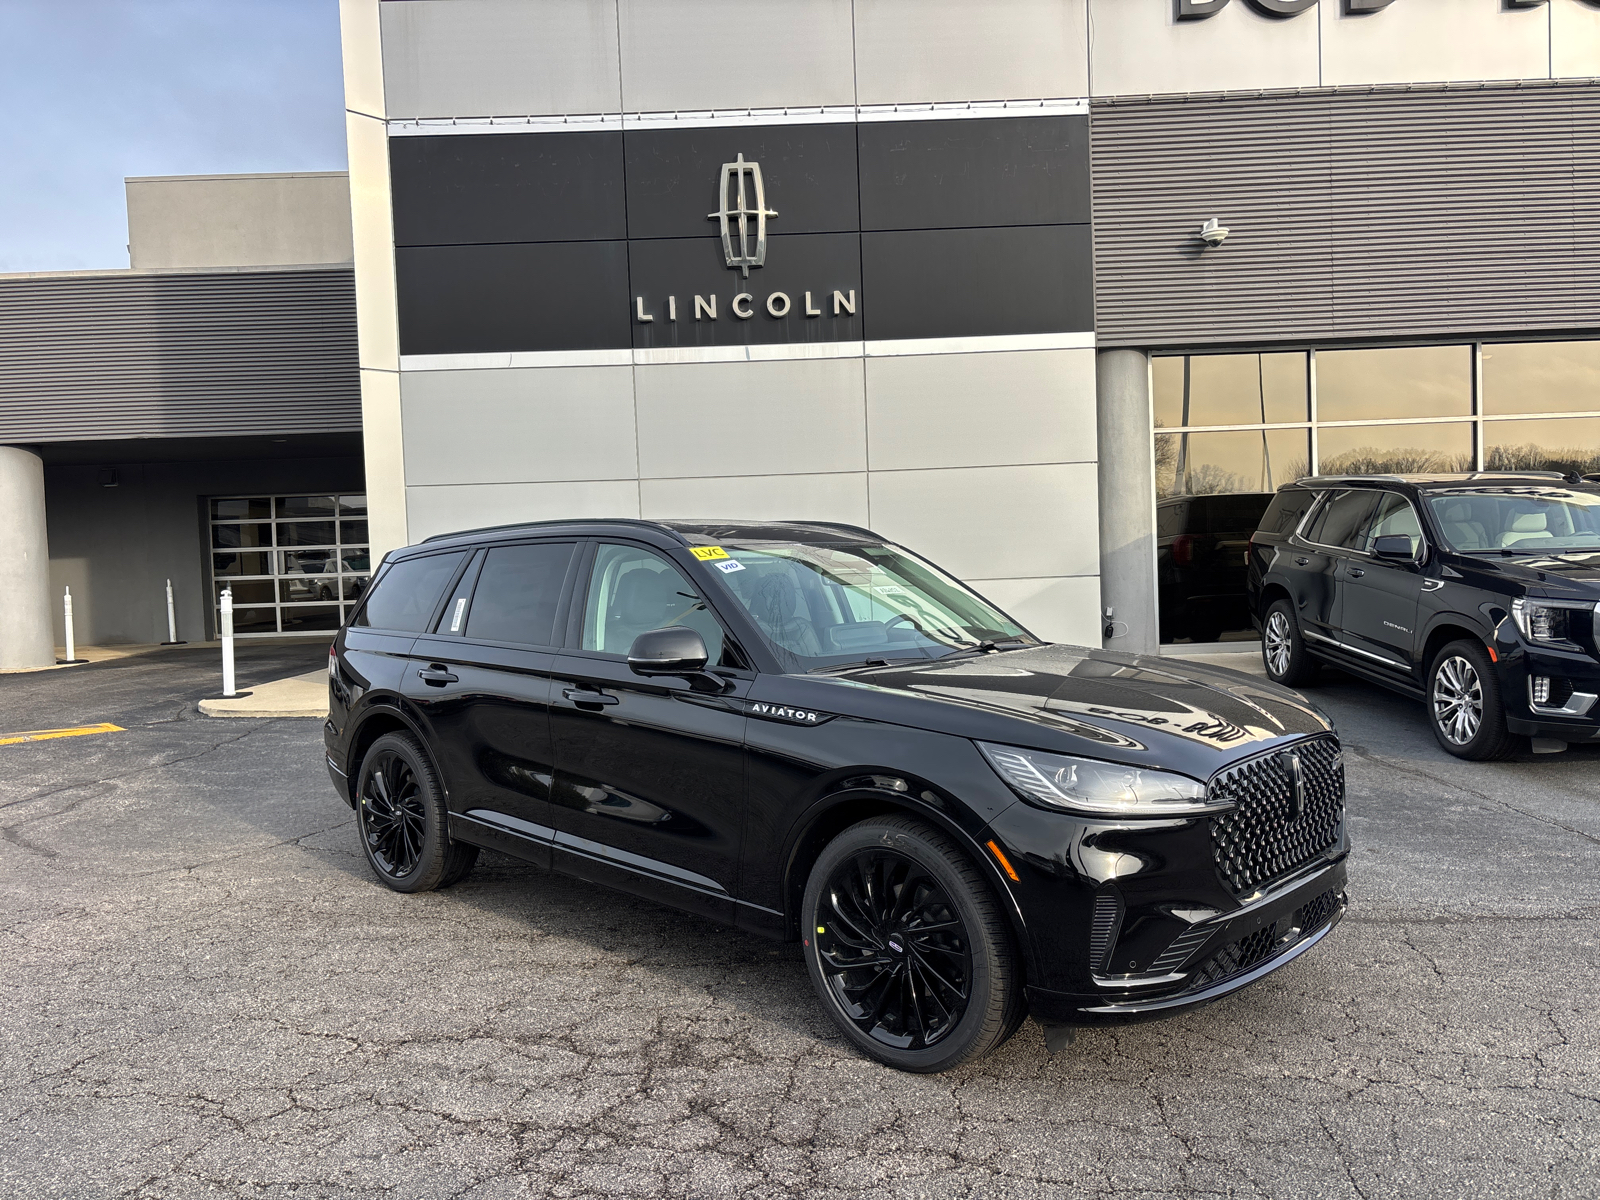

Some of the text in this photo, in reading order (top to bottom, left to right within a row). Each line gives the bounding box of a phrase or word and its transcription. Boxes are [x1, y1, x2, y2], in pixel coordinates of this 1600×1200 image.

[636, 289, 857, 322] LINCOLN
[693, 548, 725, 558] LVC
[1383, 620, 1413, 634] DENALI
[752, 703, 817, 722] AVIATOR
